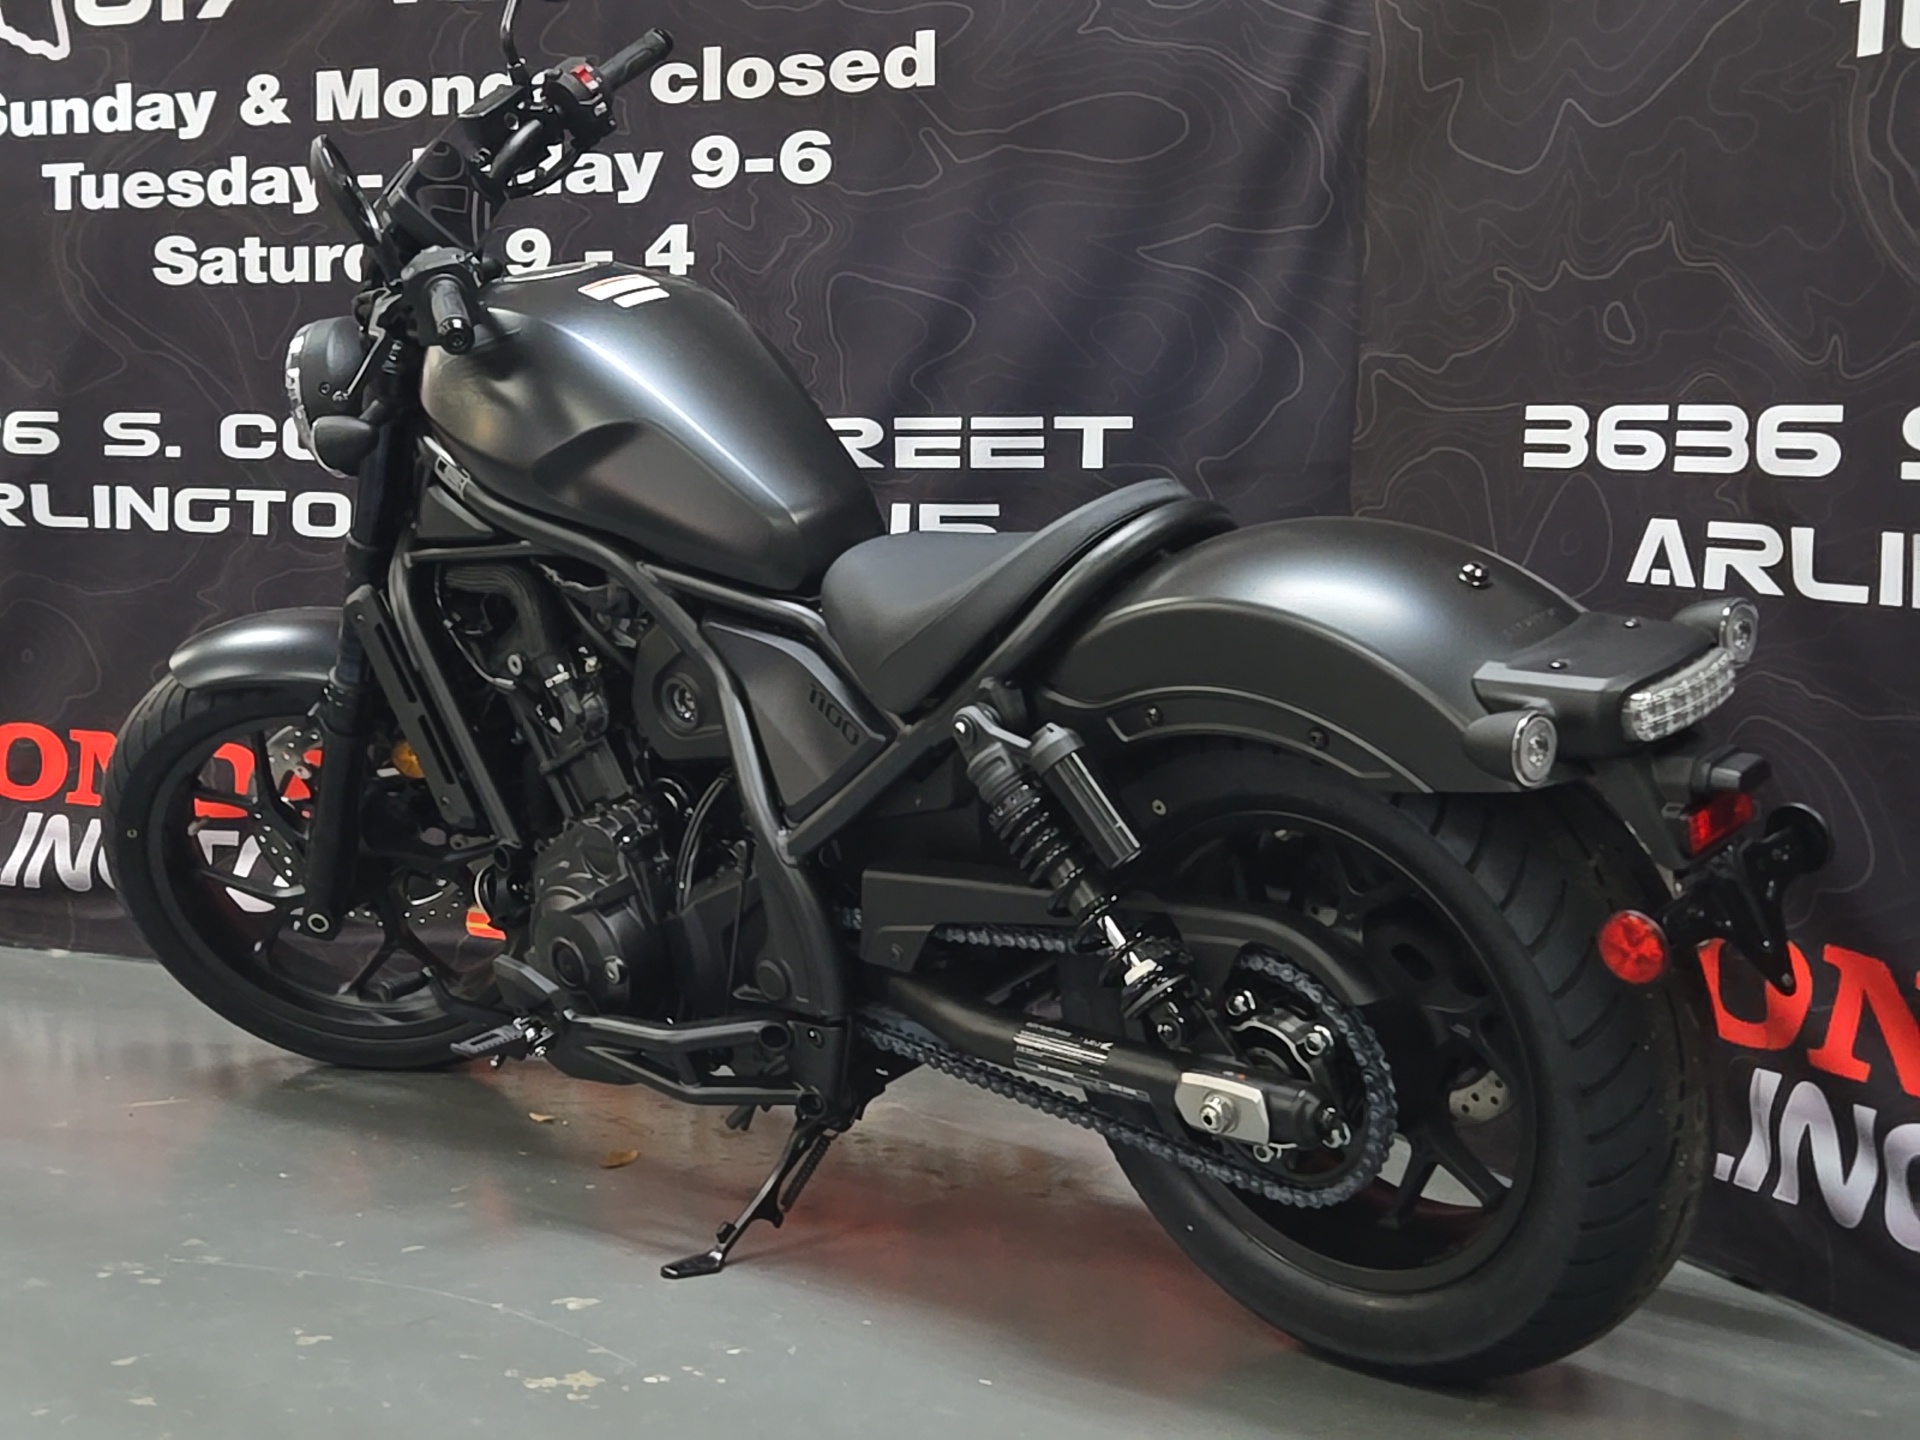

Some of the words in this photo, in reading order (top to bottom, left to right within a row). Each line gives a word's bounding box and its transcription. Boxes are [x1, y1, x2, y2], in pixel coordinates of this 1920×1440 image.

[239, 73, 292, 127] &
[315, 67, 551, 121] Mon
[650, 29, 936, 104] closed
[41, 155, 320, 215] Tuesday
[690, 129, 832, 189] 9-6
[152, 235, 364, 286] Satur
[505, 228, 552, 276] 9
[645, 223, 695, 276] 4
[0, 411, 60, 455] 6
[103, 412, 181, 458] S.
[826, 415, 1134, 469] REET
[1522, 404, 1844, 477] 3636
[1626, 517, 1920, 609] ARLI
